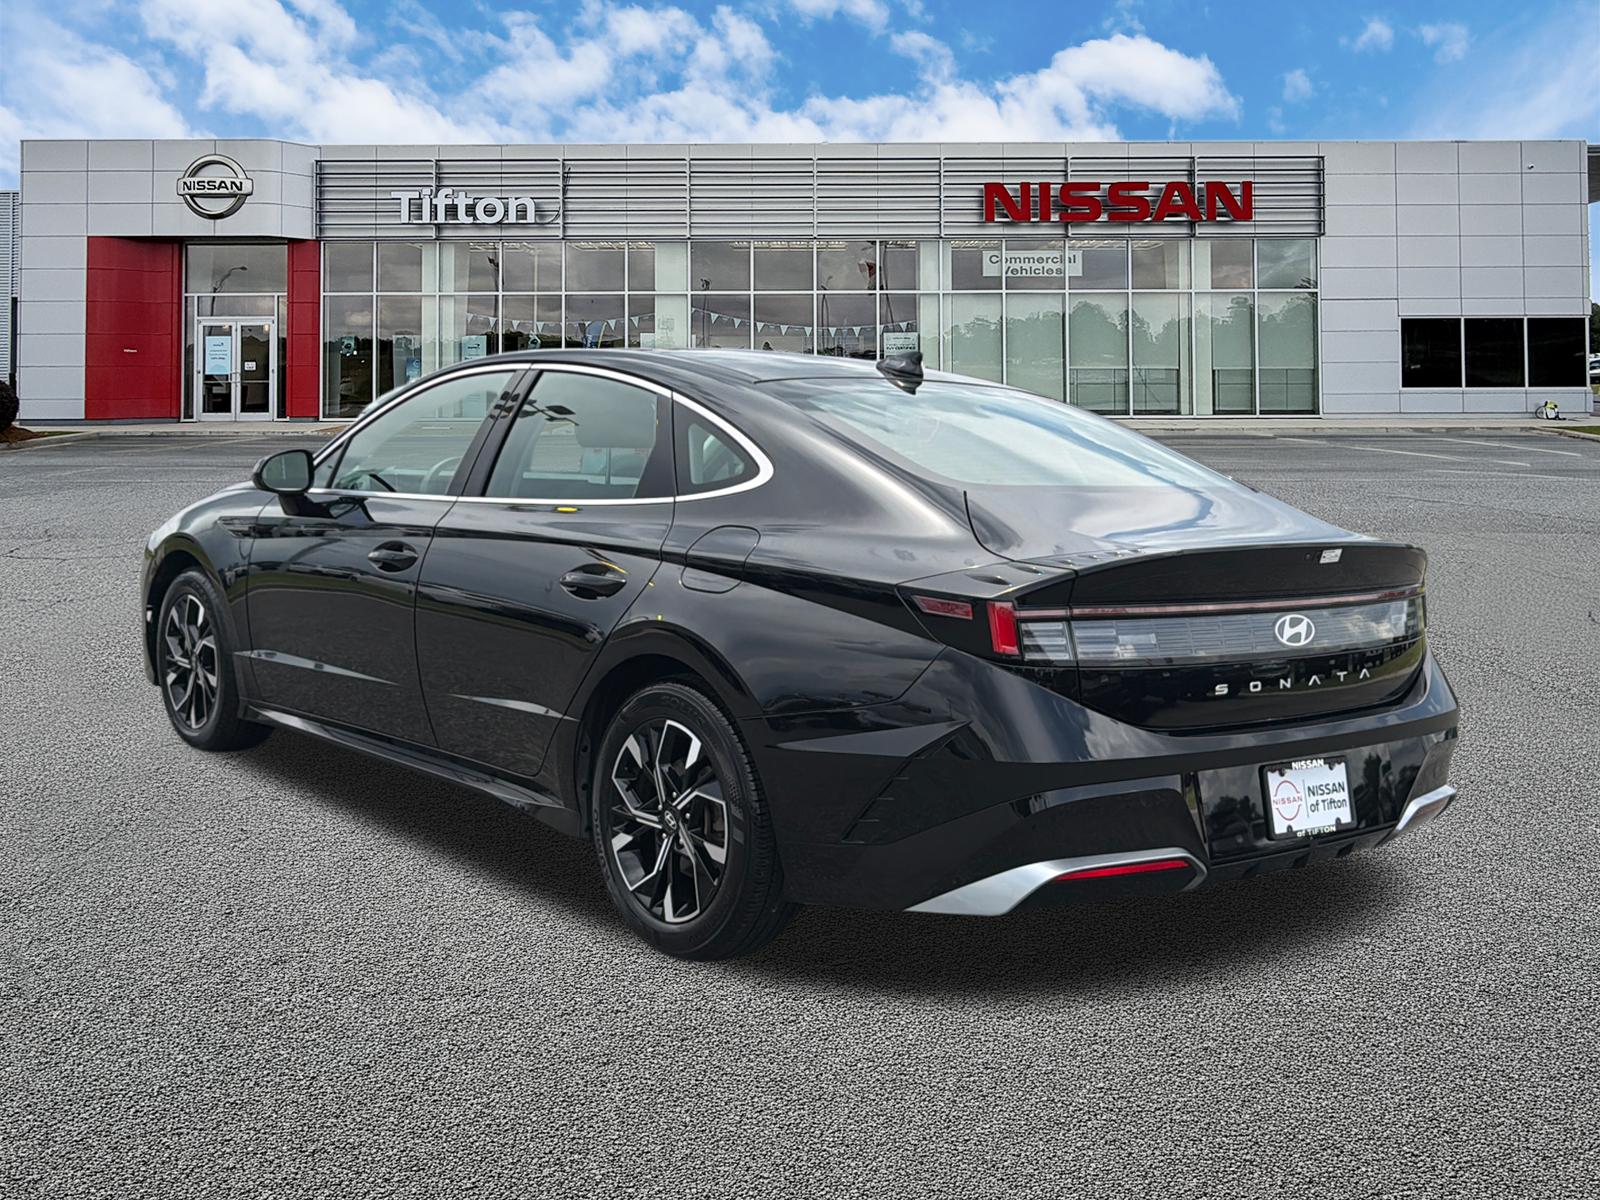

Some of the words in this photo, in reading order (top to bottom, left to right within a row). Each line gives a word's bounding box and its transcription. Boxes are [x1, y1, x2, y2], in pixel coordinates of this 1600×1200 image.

[182, 180, 243, 191] NISSAN
[391, 188, 536, 224] Tifton
[984, 181, 1253, 222] NISSAN
[1214, 668, 1370, 695] SONATA
[1291, 759, 1324, 771] NISSAN
[1307, 781, 1345, 797] NISSAN
[1272, 796, 1303, 806] NISSAN
[1309, 801, 1320, 813] of
[1321, 797, 1347, 811] Tifton
